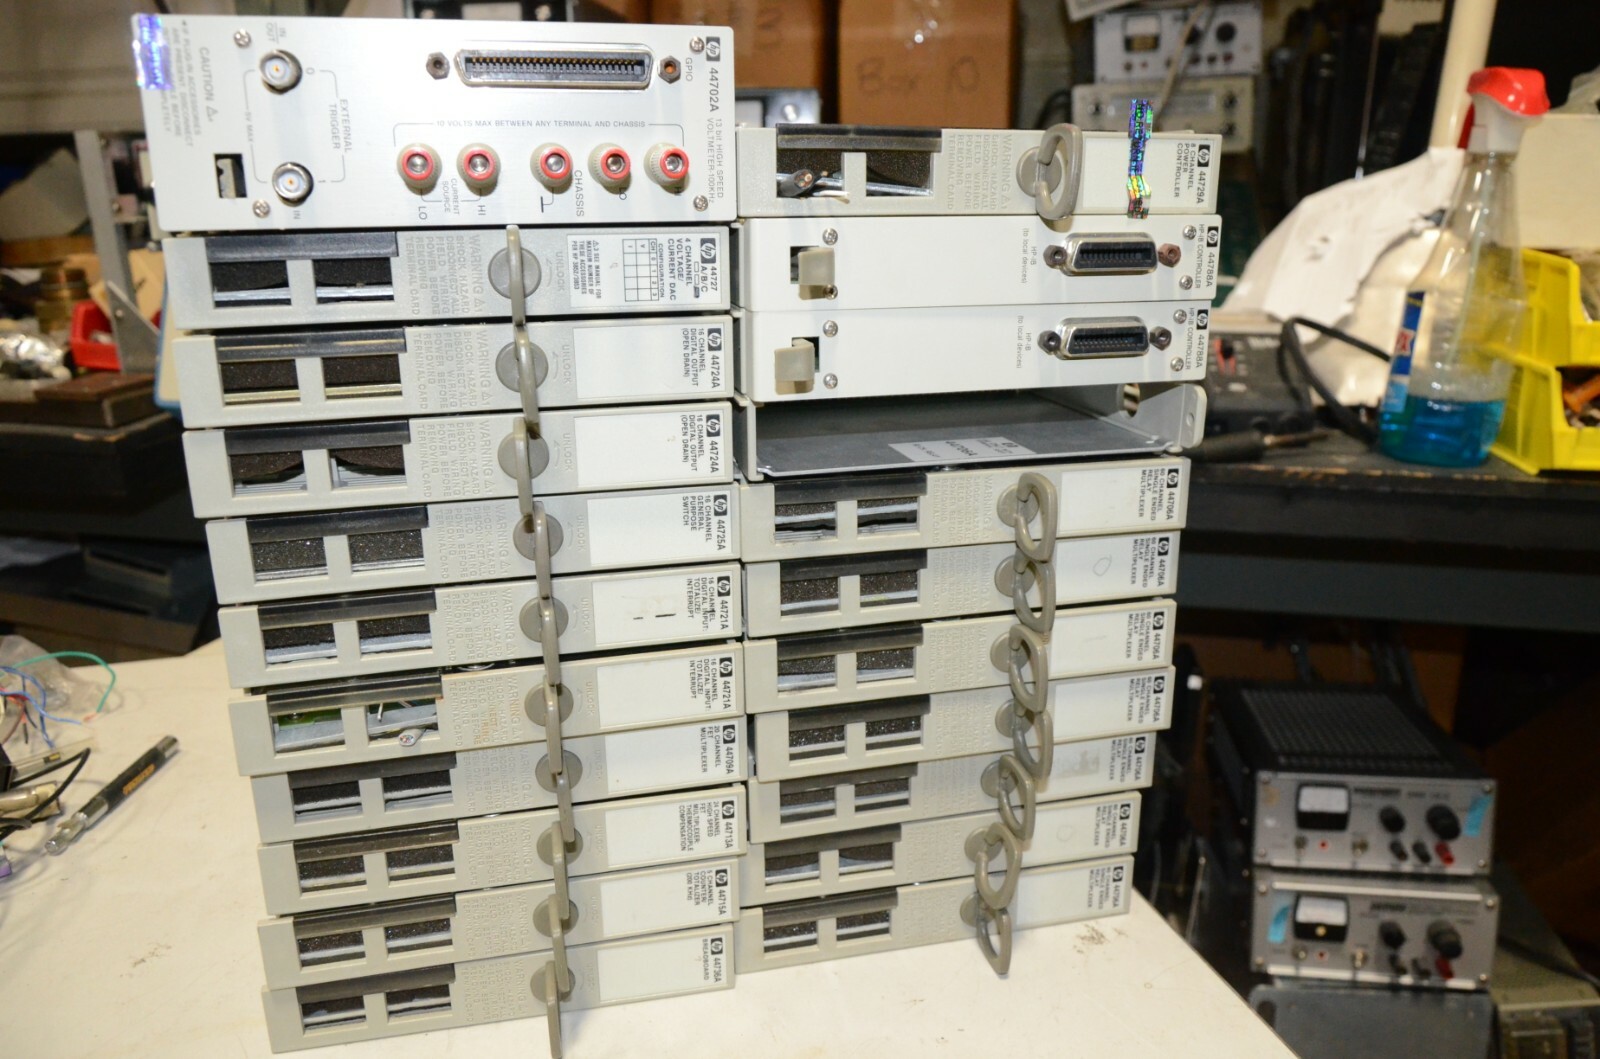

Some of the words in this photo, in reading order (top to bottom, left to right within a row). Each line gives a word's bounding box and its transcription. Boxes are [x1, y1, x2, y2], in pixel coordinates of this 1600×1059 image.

[199, 47, 214, 101] CAUTION
[685, 58, 693, 82] GPIO
[709, 67, 719, 112] 44702A
[328, 104, 341, 149] TRIGGER
[339, 99, 352, 152] EXTERNAL
[495, 120, 532, 128] BETWEEN
[534, 120, 550, 128] ANY
[554, 120, 591, 128] TERMINAL
[594, 120, 609, 128] AND
[1001, 134, 1012, 191] WARNING
[1174, 143, 1183, 198] CONTROLLER
[1187, 151, 1195, 190] CHANNEL
[443, 180, 452, 212] SOURCE
[450, 177, 459, 215] CURRENT
[574, 170, 584, 217] CHASSIS
[1196, 171, 1206, 204] 44729A
[293, 210, 300, 219] IN
[418, 206, 427, 220] LO
[478, 205, 486, 216] HI
[1022, 239, 1030, 255] local
[469, 234, 483, 294] WARNING
[1021, 257, 1029, 284] devices)
[1195, 244, 1203, 289] CONTROLLER
[1205, 252, 1216, 287] 44788A
[1187, 307, 1195, 326] HP-IB
[681, 328, 689, 350] (OPEN
[1024, 332, 1032, 351] HP-IB
[1185, 327, 1194, 370] CONTROLLER
[1195, 334, 1205, 368] 44788A
[711, 355, 720, 388] 44724A
[710, 440, 719, 473] 44724A
[705, 495, 711, 503] 16
[1138, 470, 1146, 517] MULTIPLEXER
[1166, 491, 1175, 520] 44706A
[716, 519, 726, 551] 44725A
[720, 600, 728, 630] 44721A
[722, 680, 731, 709] 44721A
[725, 746, 734, 774] 44709A
[686, 804, 694, 851] THERMOCOUPLE
[725, 822, 733, 848] 44713A
[718, 890, 726, 915] 44715A
[702, 939, 710, 981] BREADBOARD
